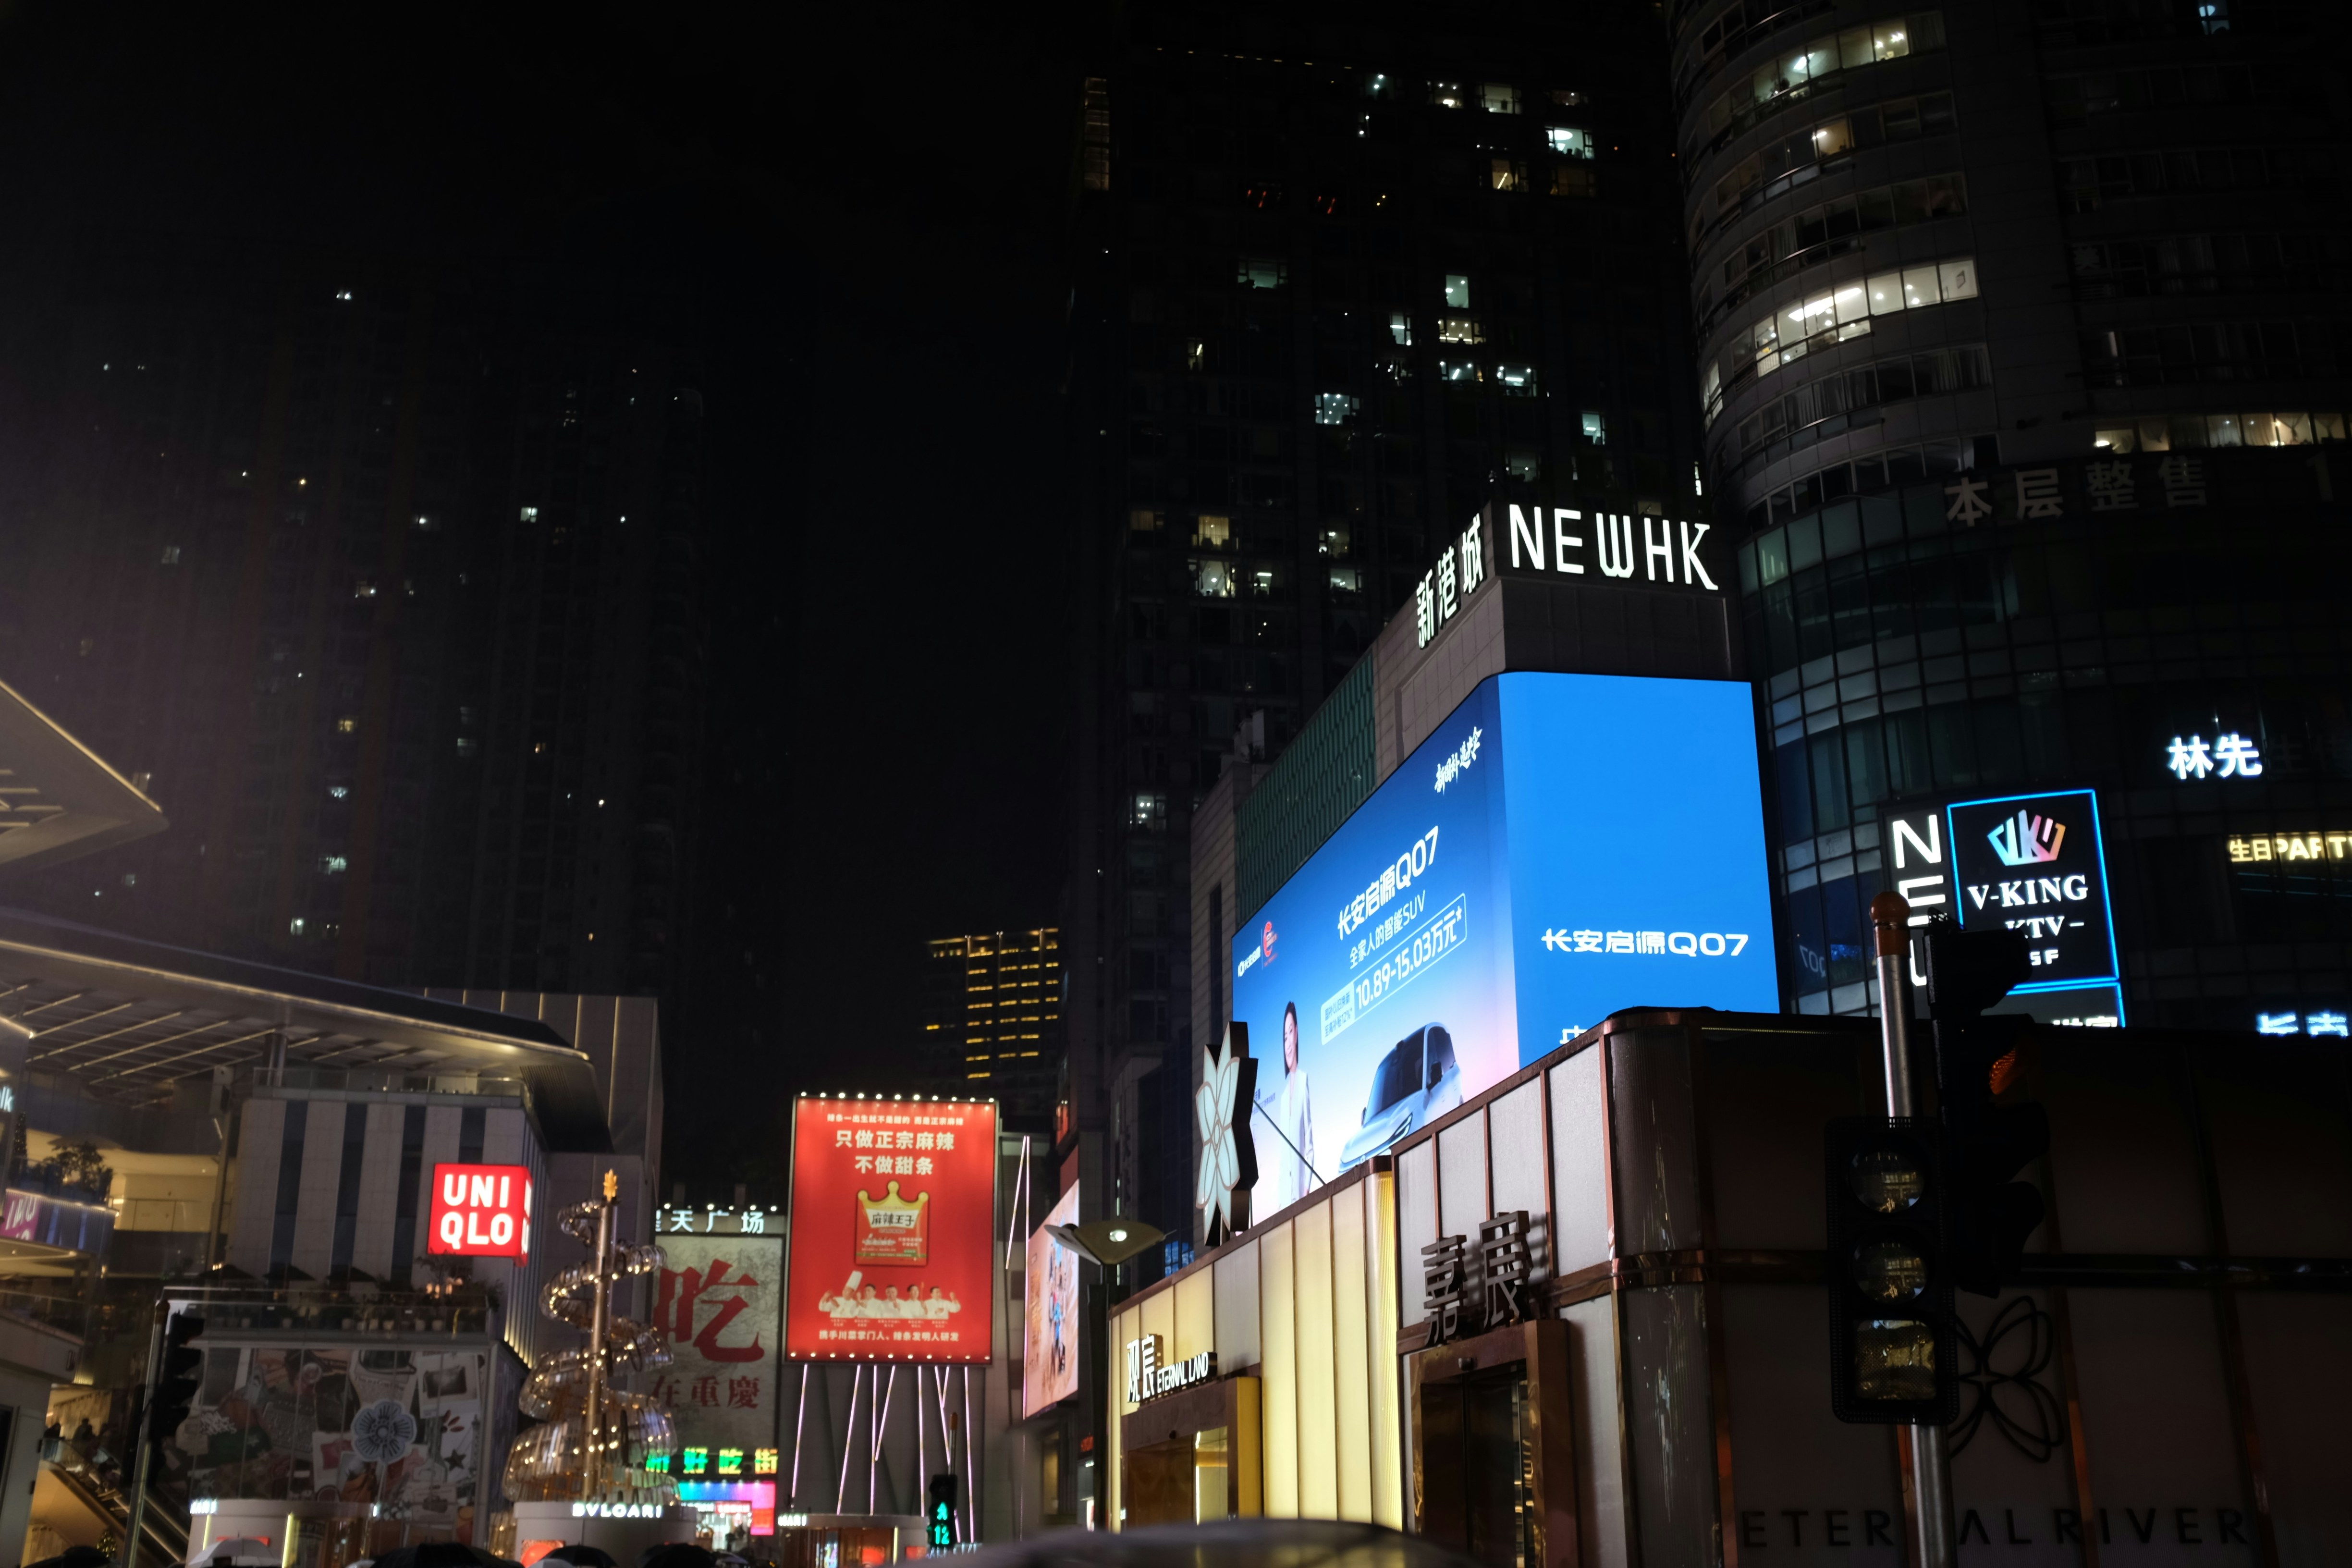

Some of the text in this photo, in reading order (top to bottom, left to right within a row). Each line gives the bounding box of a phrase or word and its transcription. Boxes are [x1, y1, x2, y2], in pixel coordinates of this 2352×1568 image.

[1509, 504, 1718, 590] NEWHK
[1416, 513, 1483, 649] 新港城
[1337, 825, 1439, 941] 长安启源Q07
[1967, 875, 2089, 910] V-KING
[1349, 889, 1426, 970] 全家人的智能SUV
[1541, 928, 1749, 957] 长安启源Q07
[835, 1129, 955, 1151] 只做正宗麻辣
[855, 1155, 934, 1176] 不做甜条
[443, 1174, 510, 1208] UNI
[440, 1211, 514, 1250] QLO
[871, 1212, 915, 1226] 麻辣王子
[652, 1259, 765, 1363] 吃
[934, 1525, 950, 1544] 12
[1741, 1509, 2033, 1548] ETERAL
